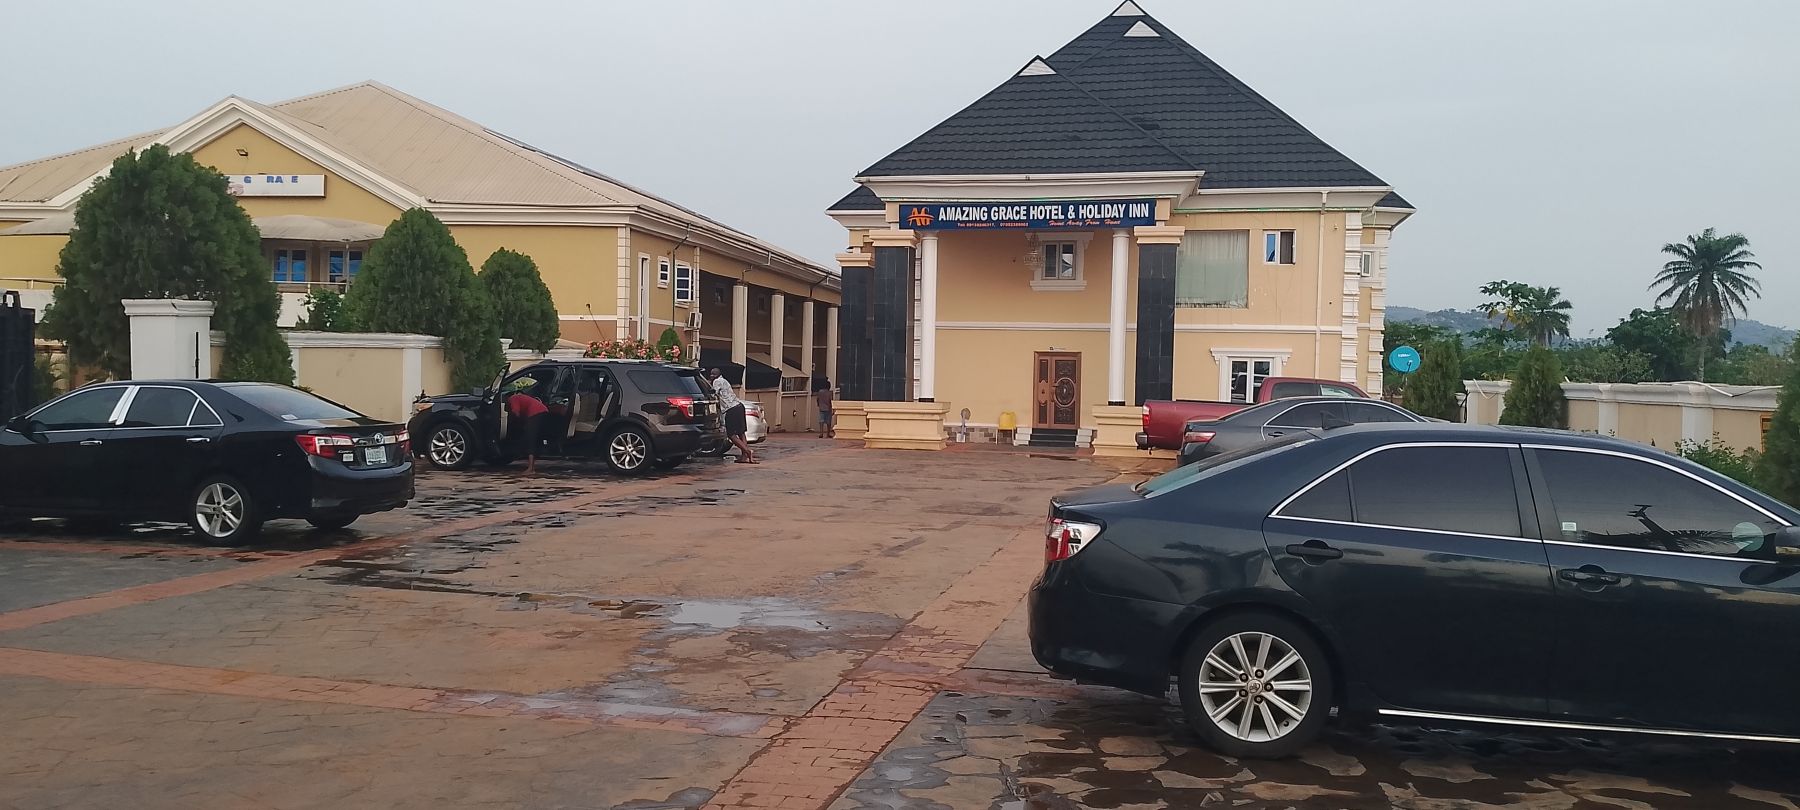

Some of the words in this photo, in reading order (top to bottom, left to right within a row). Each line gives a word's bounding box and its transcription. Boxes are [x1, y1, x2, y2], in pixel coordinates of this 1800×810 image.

[938, 207, 988, 221] AMAZING
[991, 206, 1027, 220] GRACE
[1030, 205, 1065, 220] HOTEL
[1067, 204, 1076, 219] &
[1079, 203, 1127, 219] HOLIDAY
[1129, 203, 1149, 218] INN
